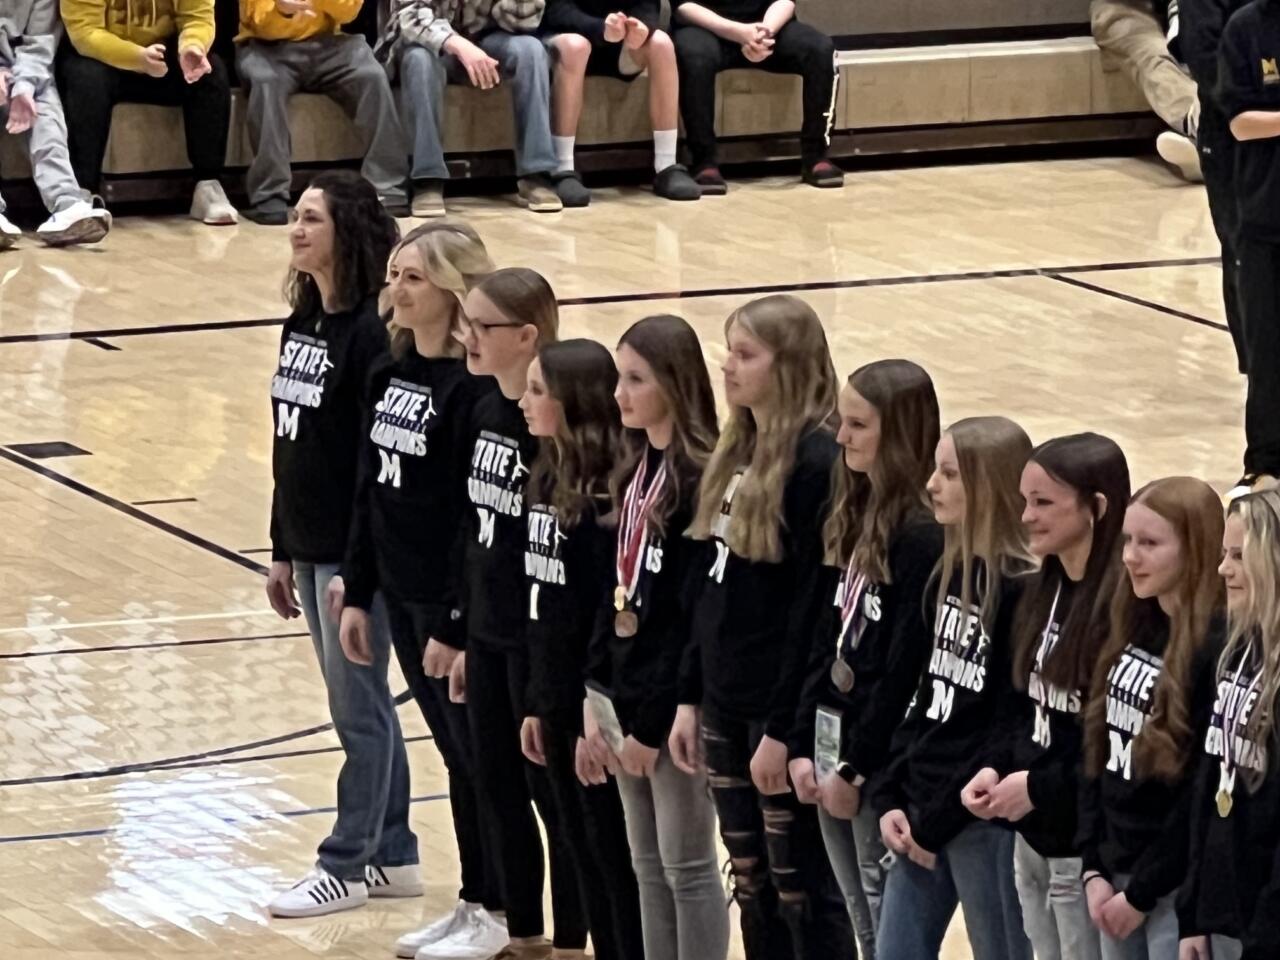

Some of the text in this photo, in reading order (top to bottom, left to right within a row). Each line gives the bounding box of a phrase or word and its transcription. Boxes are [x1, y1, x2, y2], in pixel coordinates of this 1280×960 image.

[277, 402, 300, 441] M
[377, 448, 401, 489] M
[472, 438, 514, 478] TATE
[1108, 654, 1161, 702] TATE
[1106, 729, 1132, 781] M
